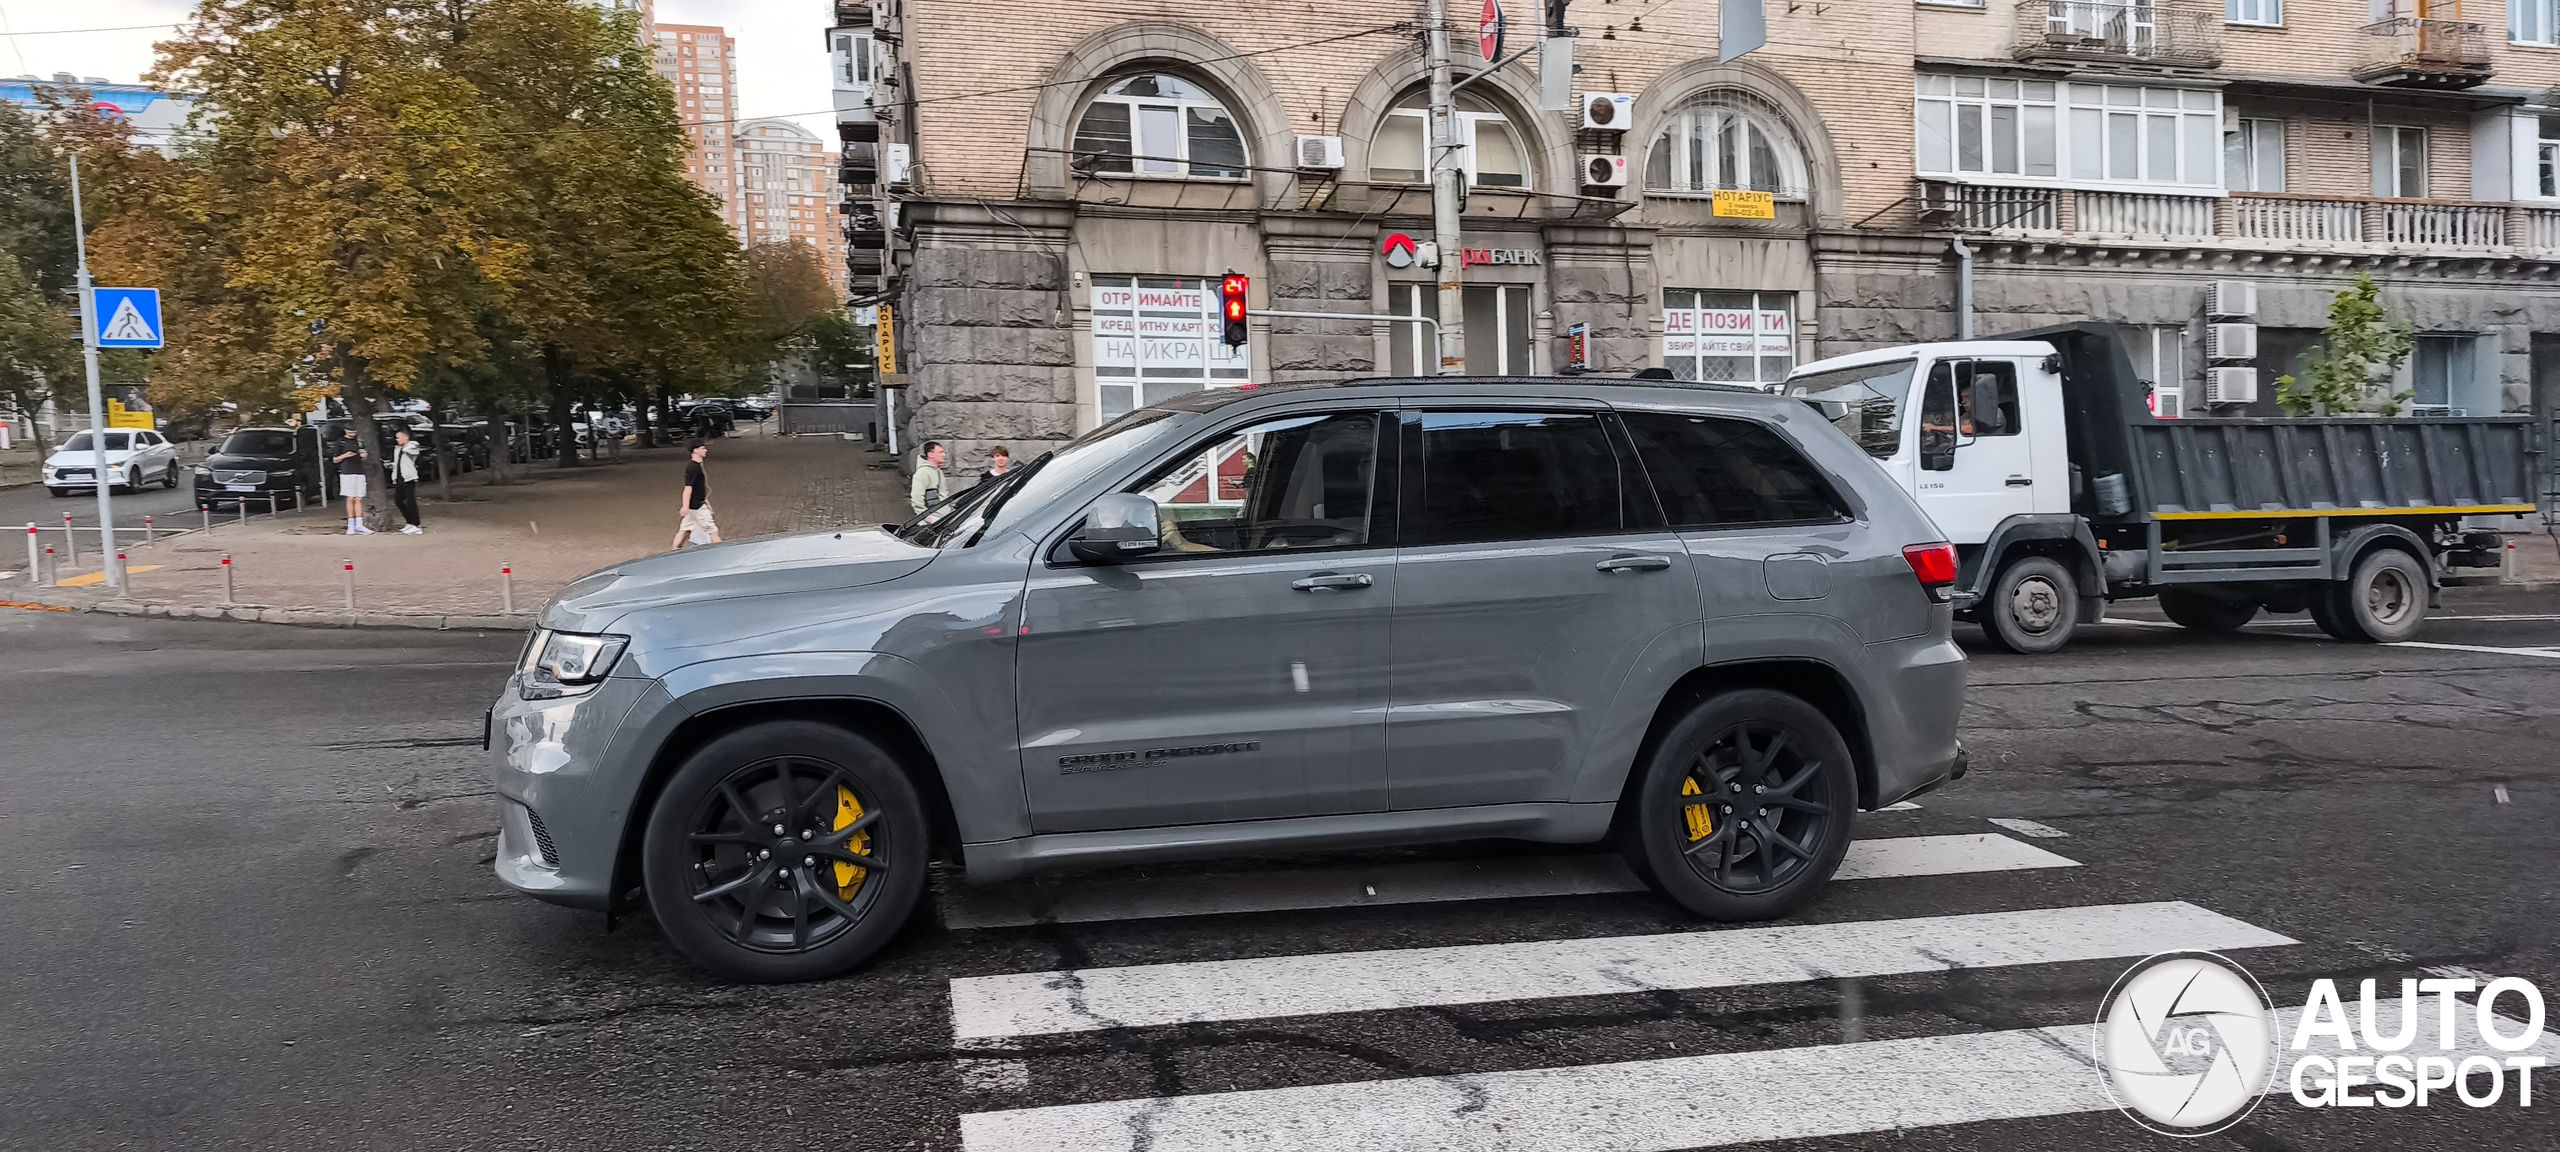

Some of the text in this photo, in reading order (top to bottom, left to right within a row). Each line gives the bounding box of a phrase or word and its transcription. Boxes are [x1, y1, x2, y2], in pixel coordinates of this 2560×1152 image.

[1713, 191, 1772, 203] НОТАРІУС
[1226, 279, 1242, 292] 24
[1102, 291, 1202, 307] ОТРИМАЙТЕ
[1101, 320, 1170, 332] КРЕДИТНУ
[1667, 312, 1784, 331] ДЕПОЗИТИ
[879, 305, 892, 370] НОТАРІУС
[1106, 339, 1244, 363] НАЙКРАЩА
[1059, 741, 1260, 765] GRAND CHEROKEE
